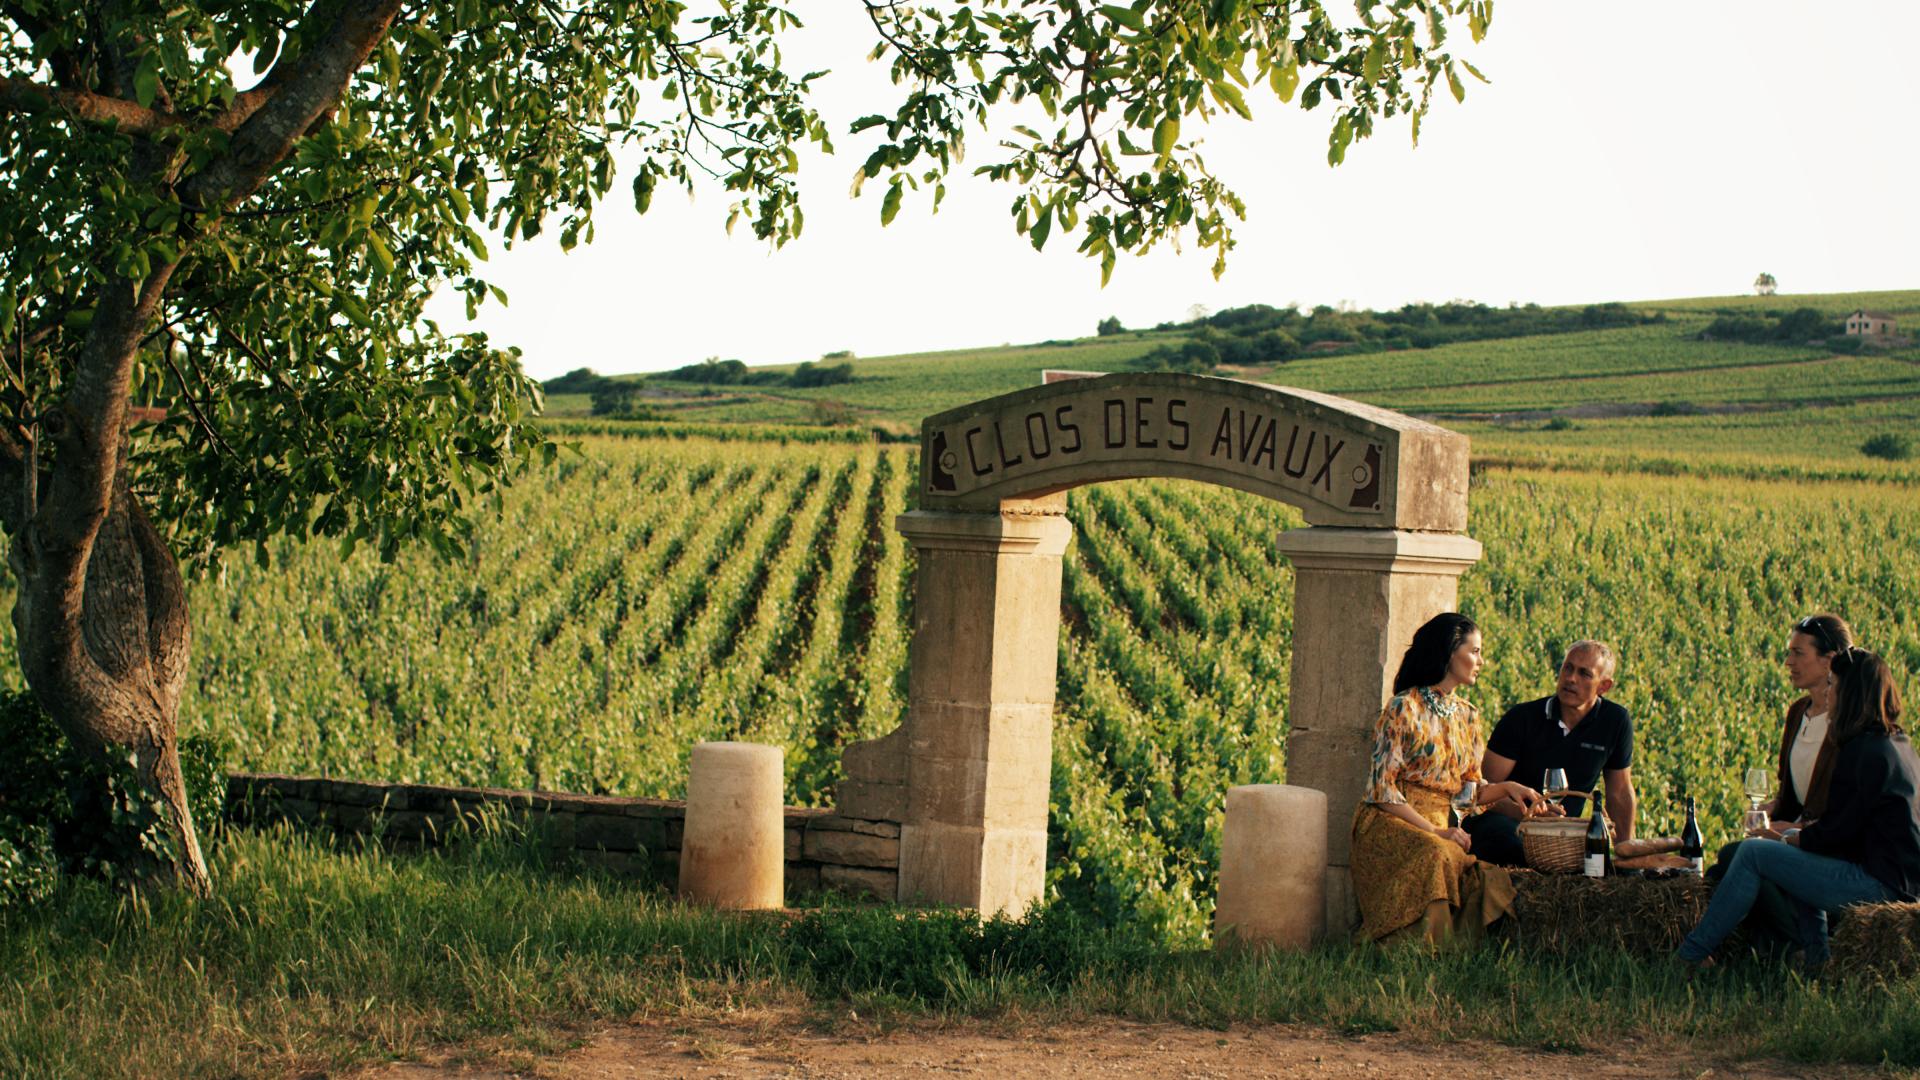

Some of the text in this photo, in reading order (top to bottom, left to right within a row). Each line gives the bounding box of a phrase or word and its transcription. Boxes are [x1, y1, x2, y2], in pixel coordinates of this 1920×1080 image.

[965, 398, 1345, 492] CLOS DES AVAUX
